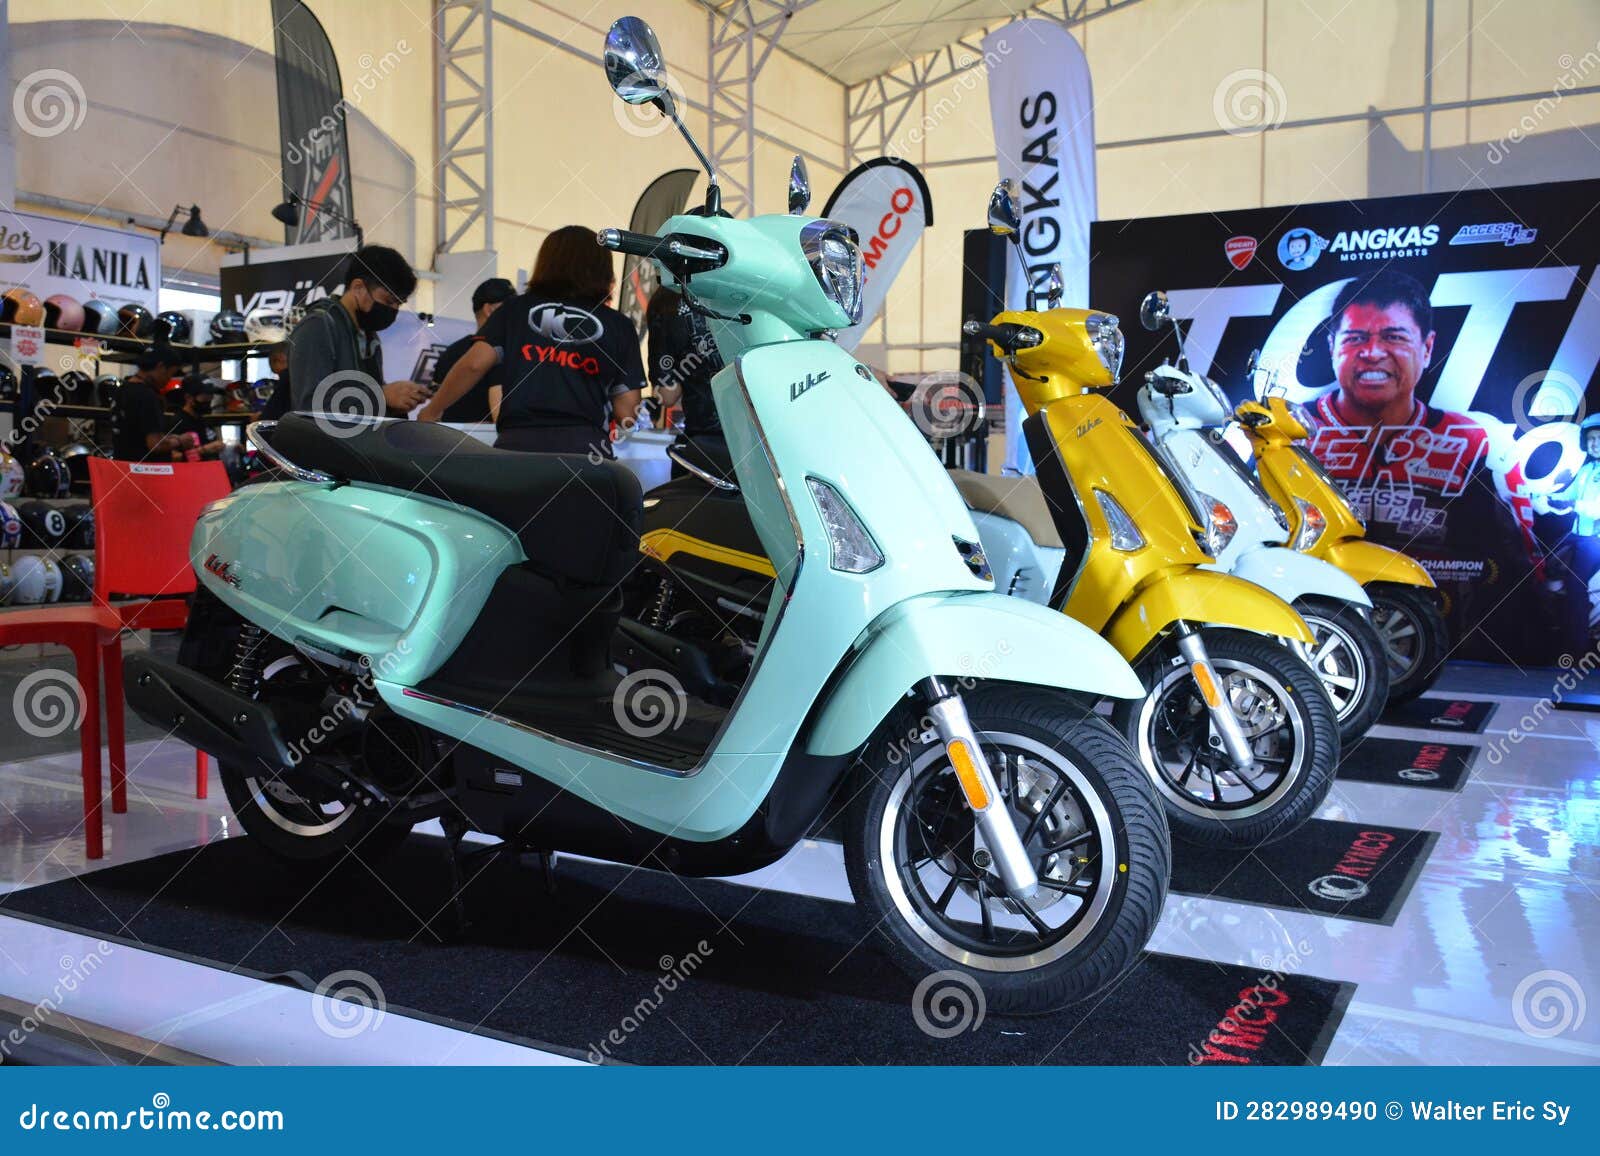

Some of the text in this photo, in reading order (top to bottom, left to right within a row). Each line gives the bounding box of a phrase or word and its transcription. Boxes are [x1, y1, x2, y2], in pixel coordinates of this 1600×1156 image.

[1020, 91, 1061, 309] NGKAS
[863, 187, 914, 270] MCO
[1329, 224, 1440, 253] ANGKAS
[1459, 223, 1513, 237] ACCESS
[48, 240, 152, 291] MANILA
[1340, 248, 1428, 262] MOTORSPORTS
[1388, 504, 1437, 523] PLUS
[1420, 559, 1484, 571] CHAMPION
[1333, 831, 1396, 877] KYMCO
[1190, 986, 1290, 1066] YMCO
